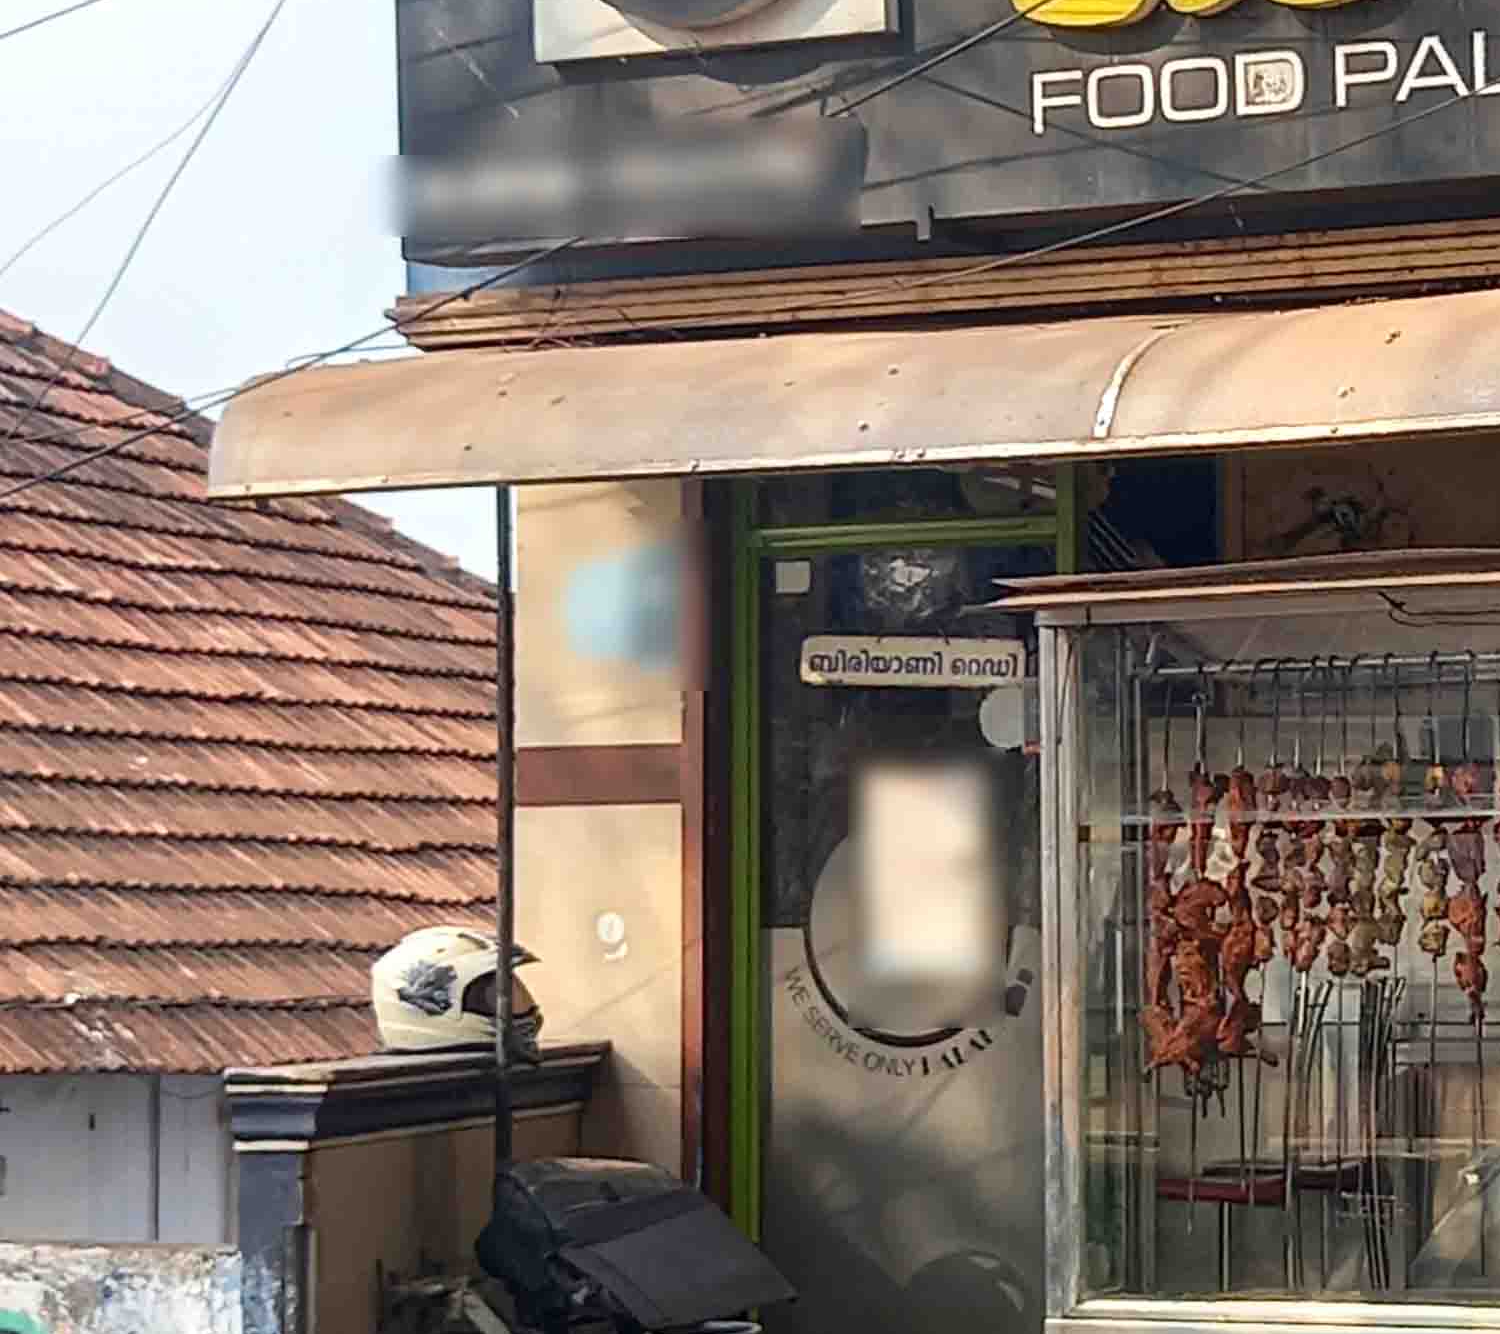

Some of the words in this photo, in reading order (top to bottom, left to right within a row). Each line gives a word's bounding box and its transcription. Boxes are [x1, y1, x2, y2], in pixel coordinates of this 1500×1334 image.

[1030, 49, 1305, 135] FOOD
[808, 648, 943, 674] ബിരിയാണി
[785, 966, 812, 1005] WE
[802, 1004, 862, 1063] SERVE
[863, 1050, 917, 1077] ONLY
